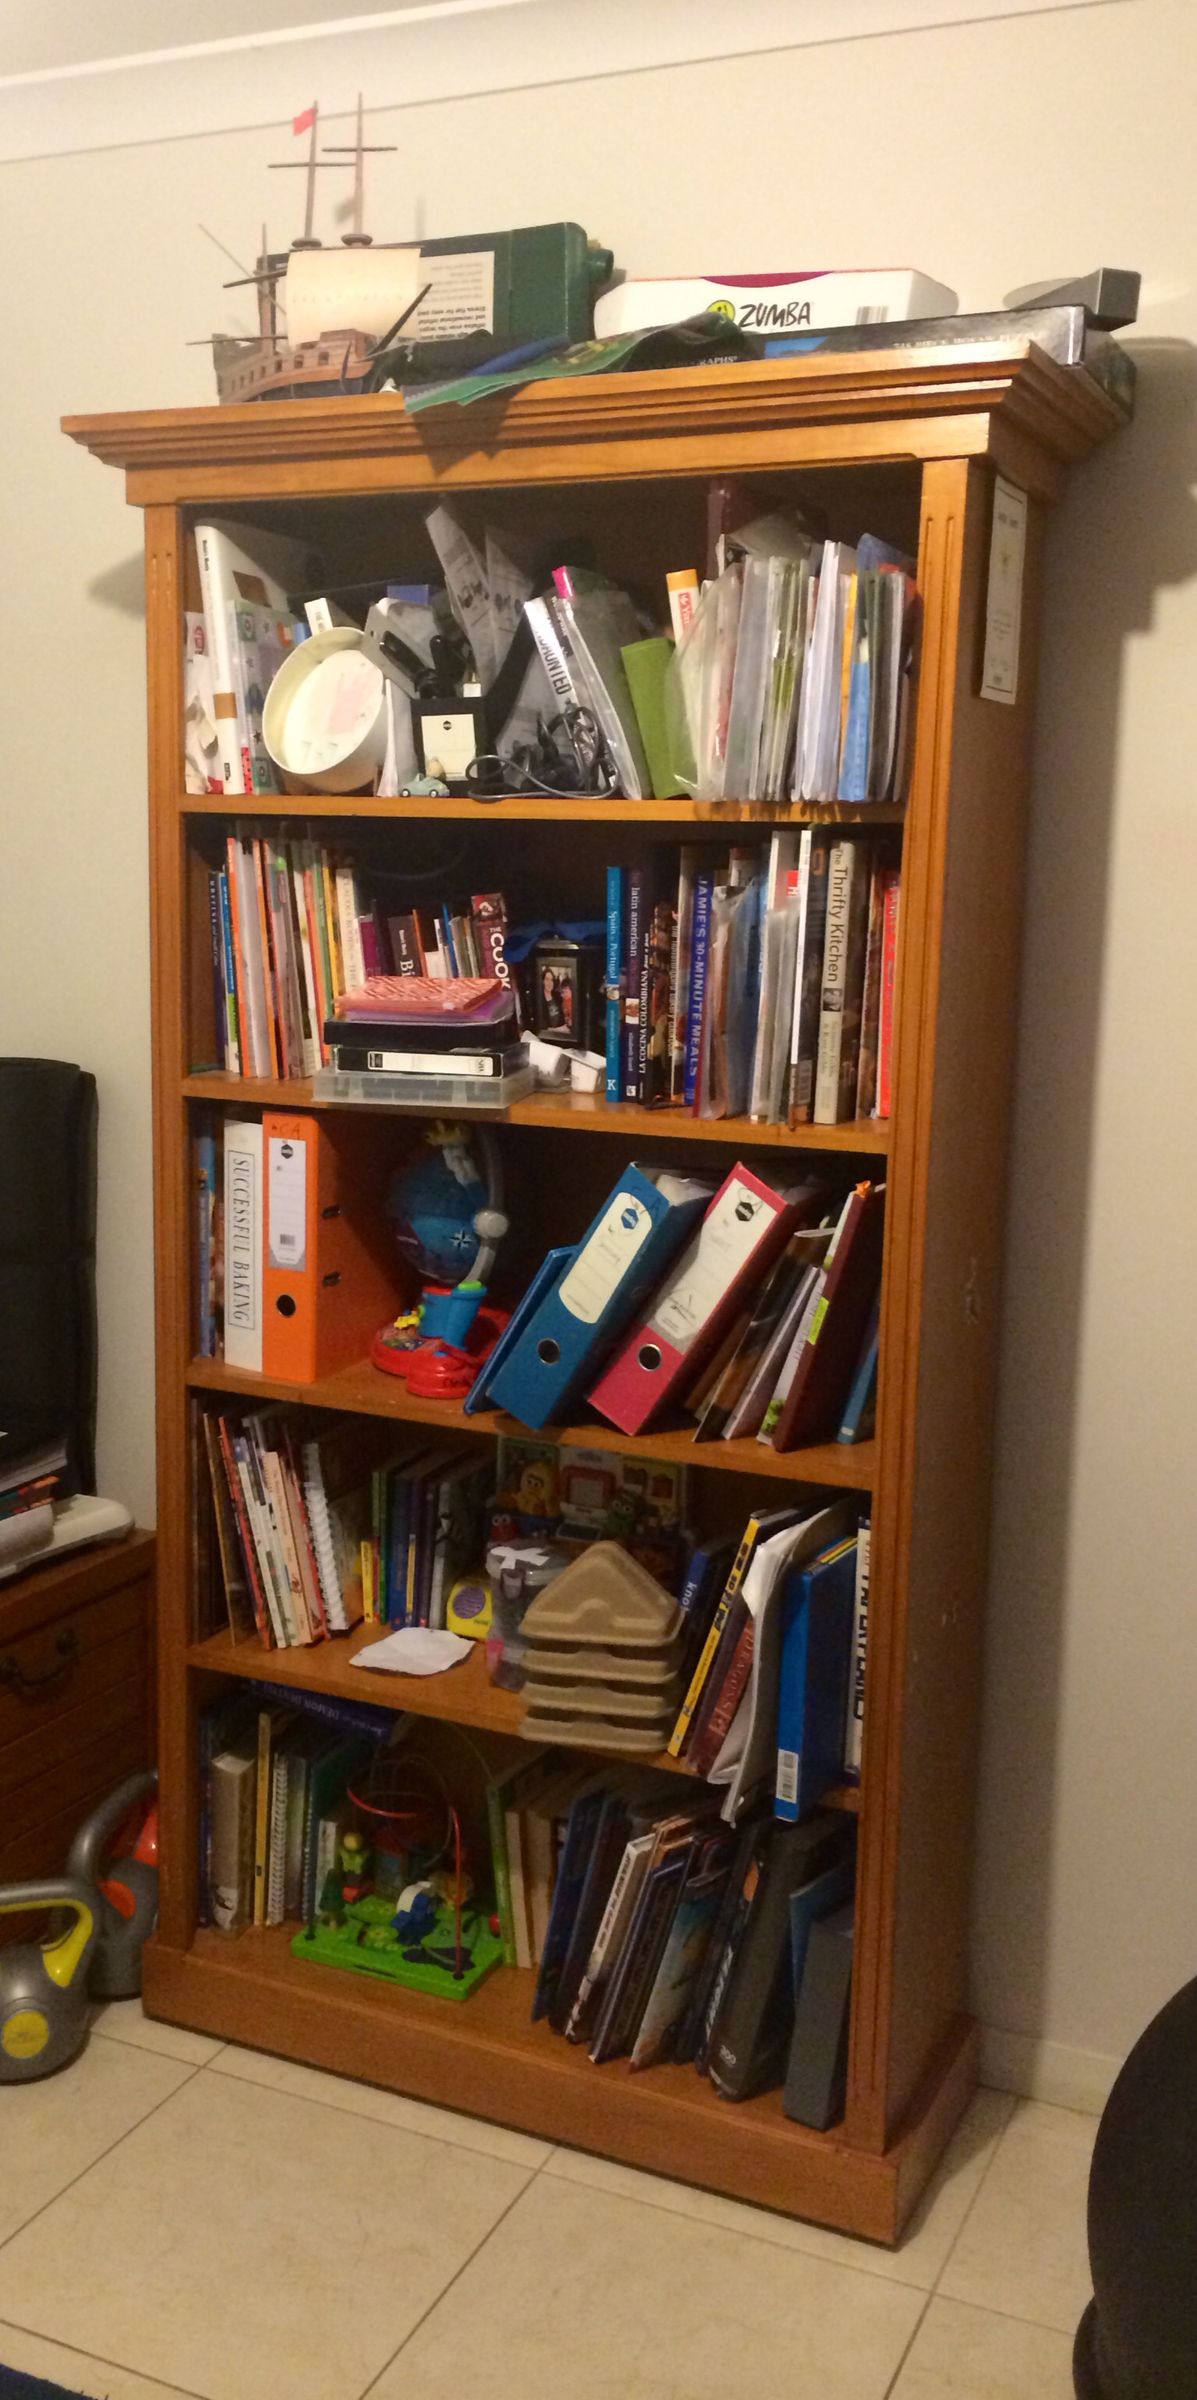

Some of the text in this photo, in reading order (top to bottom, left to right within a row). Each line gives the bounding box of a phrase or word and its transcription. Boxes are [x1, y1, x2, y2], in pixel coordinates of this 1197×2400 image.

[739, 302, 811, 328] ZUMBA
[631, 887, 640, 910] latin
[695, 879, 708, 938] JAMIE'S
[828, 866, 848, 919] Thrifty
[608, 911, 618, 934] Spain
[630, 911, 640, 957] american
[609, 943, 618, 979] Portugal
[826, 923, 845, 981] Kitchen
[640, 970, 649, 1027] COLOMBIANA
[639, 1029, 647, 1062] COCINA
[639, 1063, 646, 1074] LA
[688, 1029, 701, 1077] MEALS
[233, 1158, 250, 1320] SUCCESSFUL BAKING
